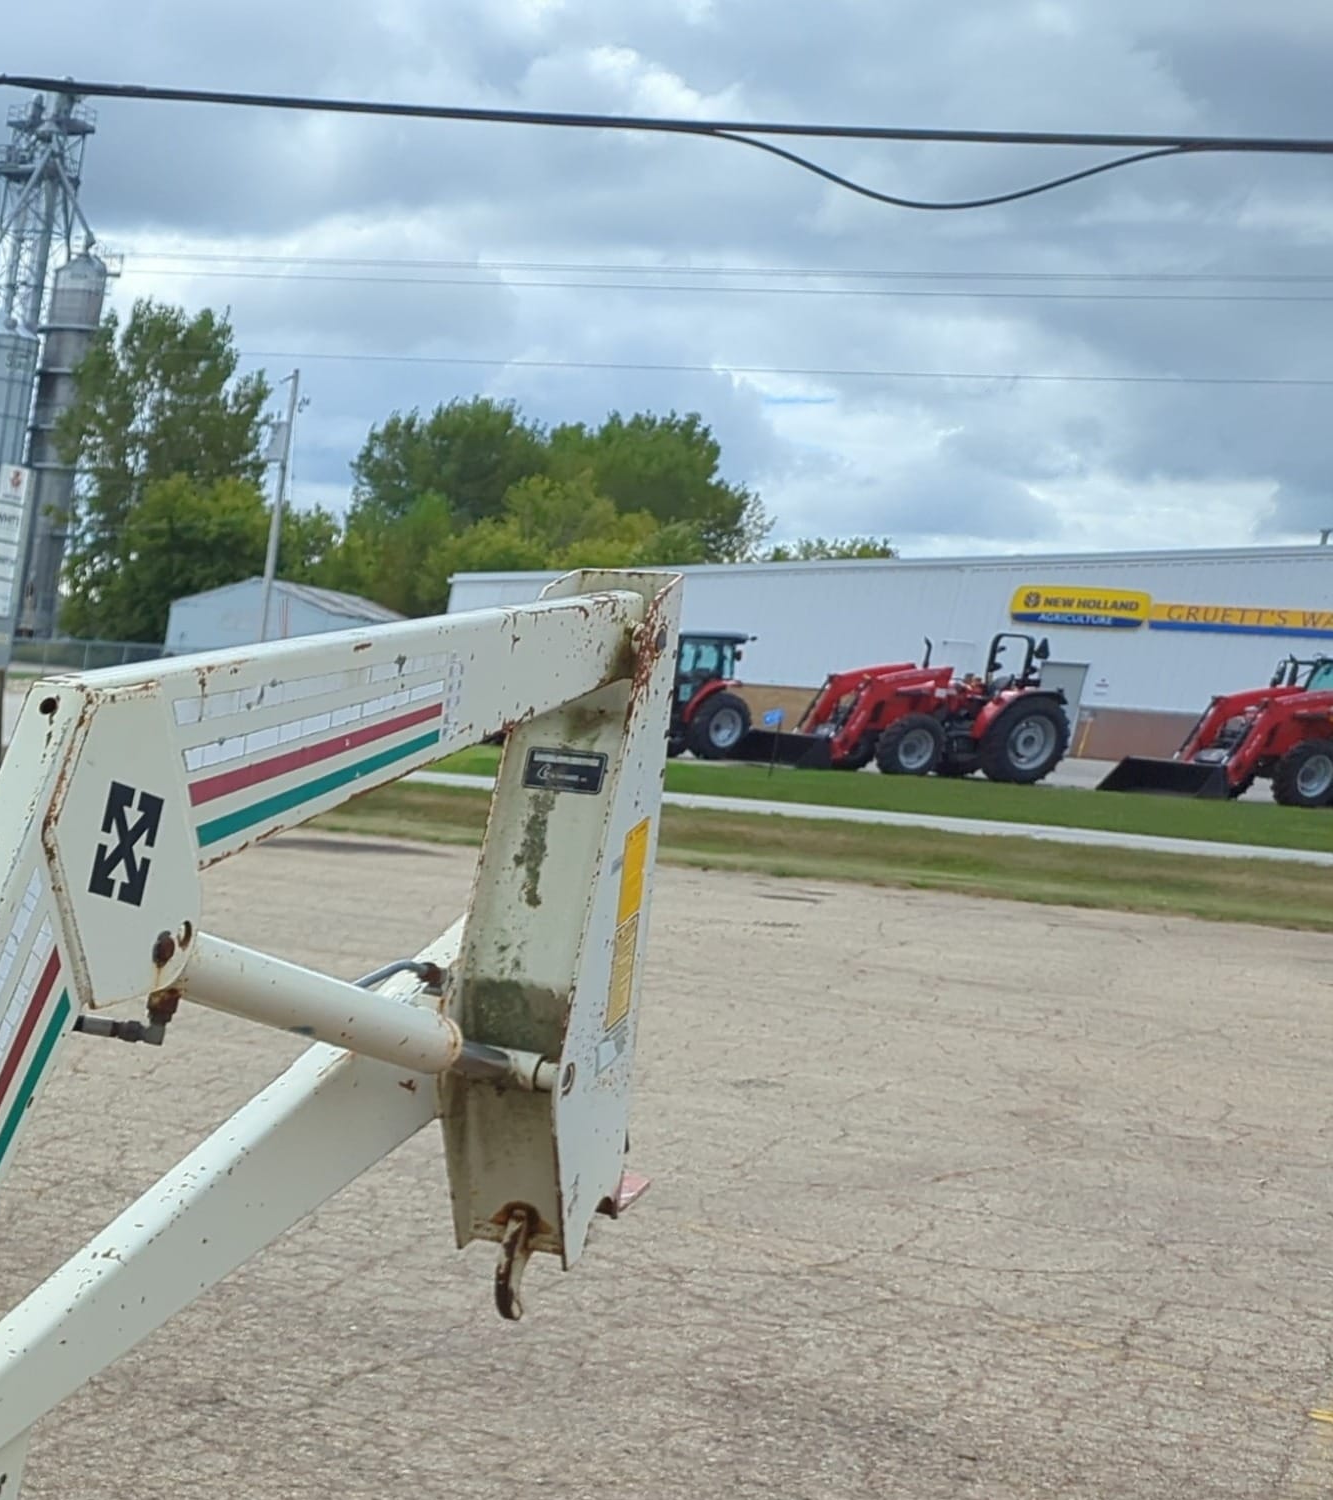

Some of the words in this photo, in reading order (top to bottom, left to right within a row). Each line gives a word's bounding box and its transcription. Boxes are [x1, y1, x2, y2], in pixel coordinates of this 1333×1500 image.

[1043, 597, 1073, 608] NEW
[1076, 598, 1140, 612] HOLLAND
[1037, 613, 1112, 625] AGRICULTURE
[1166, 604, 1290, 626] GRUETT'S
